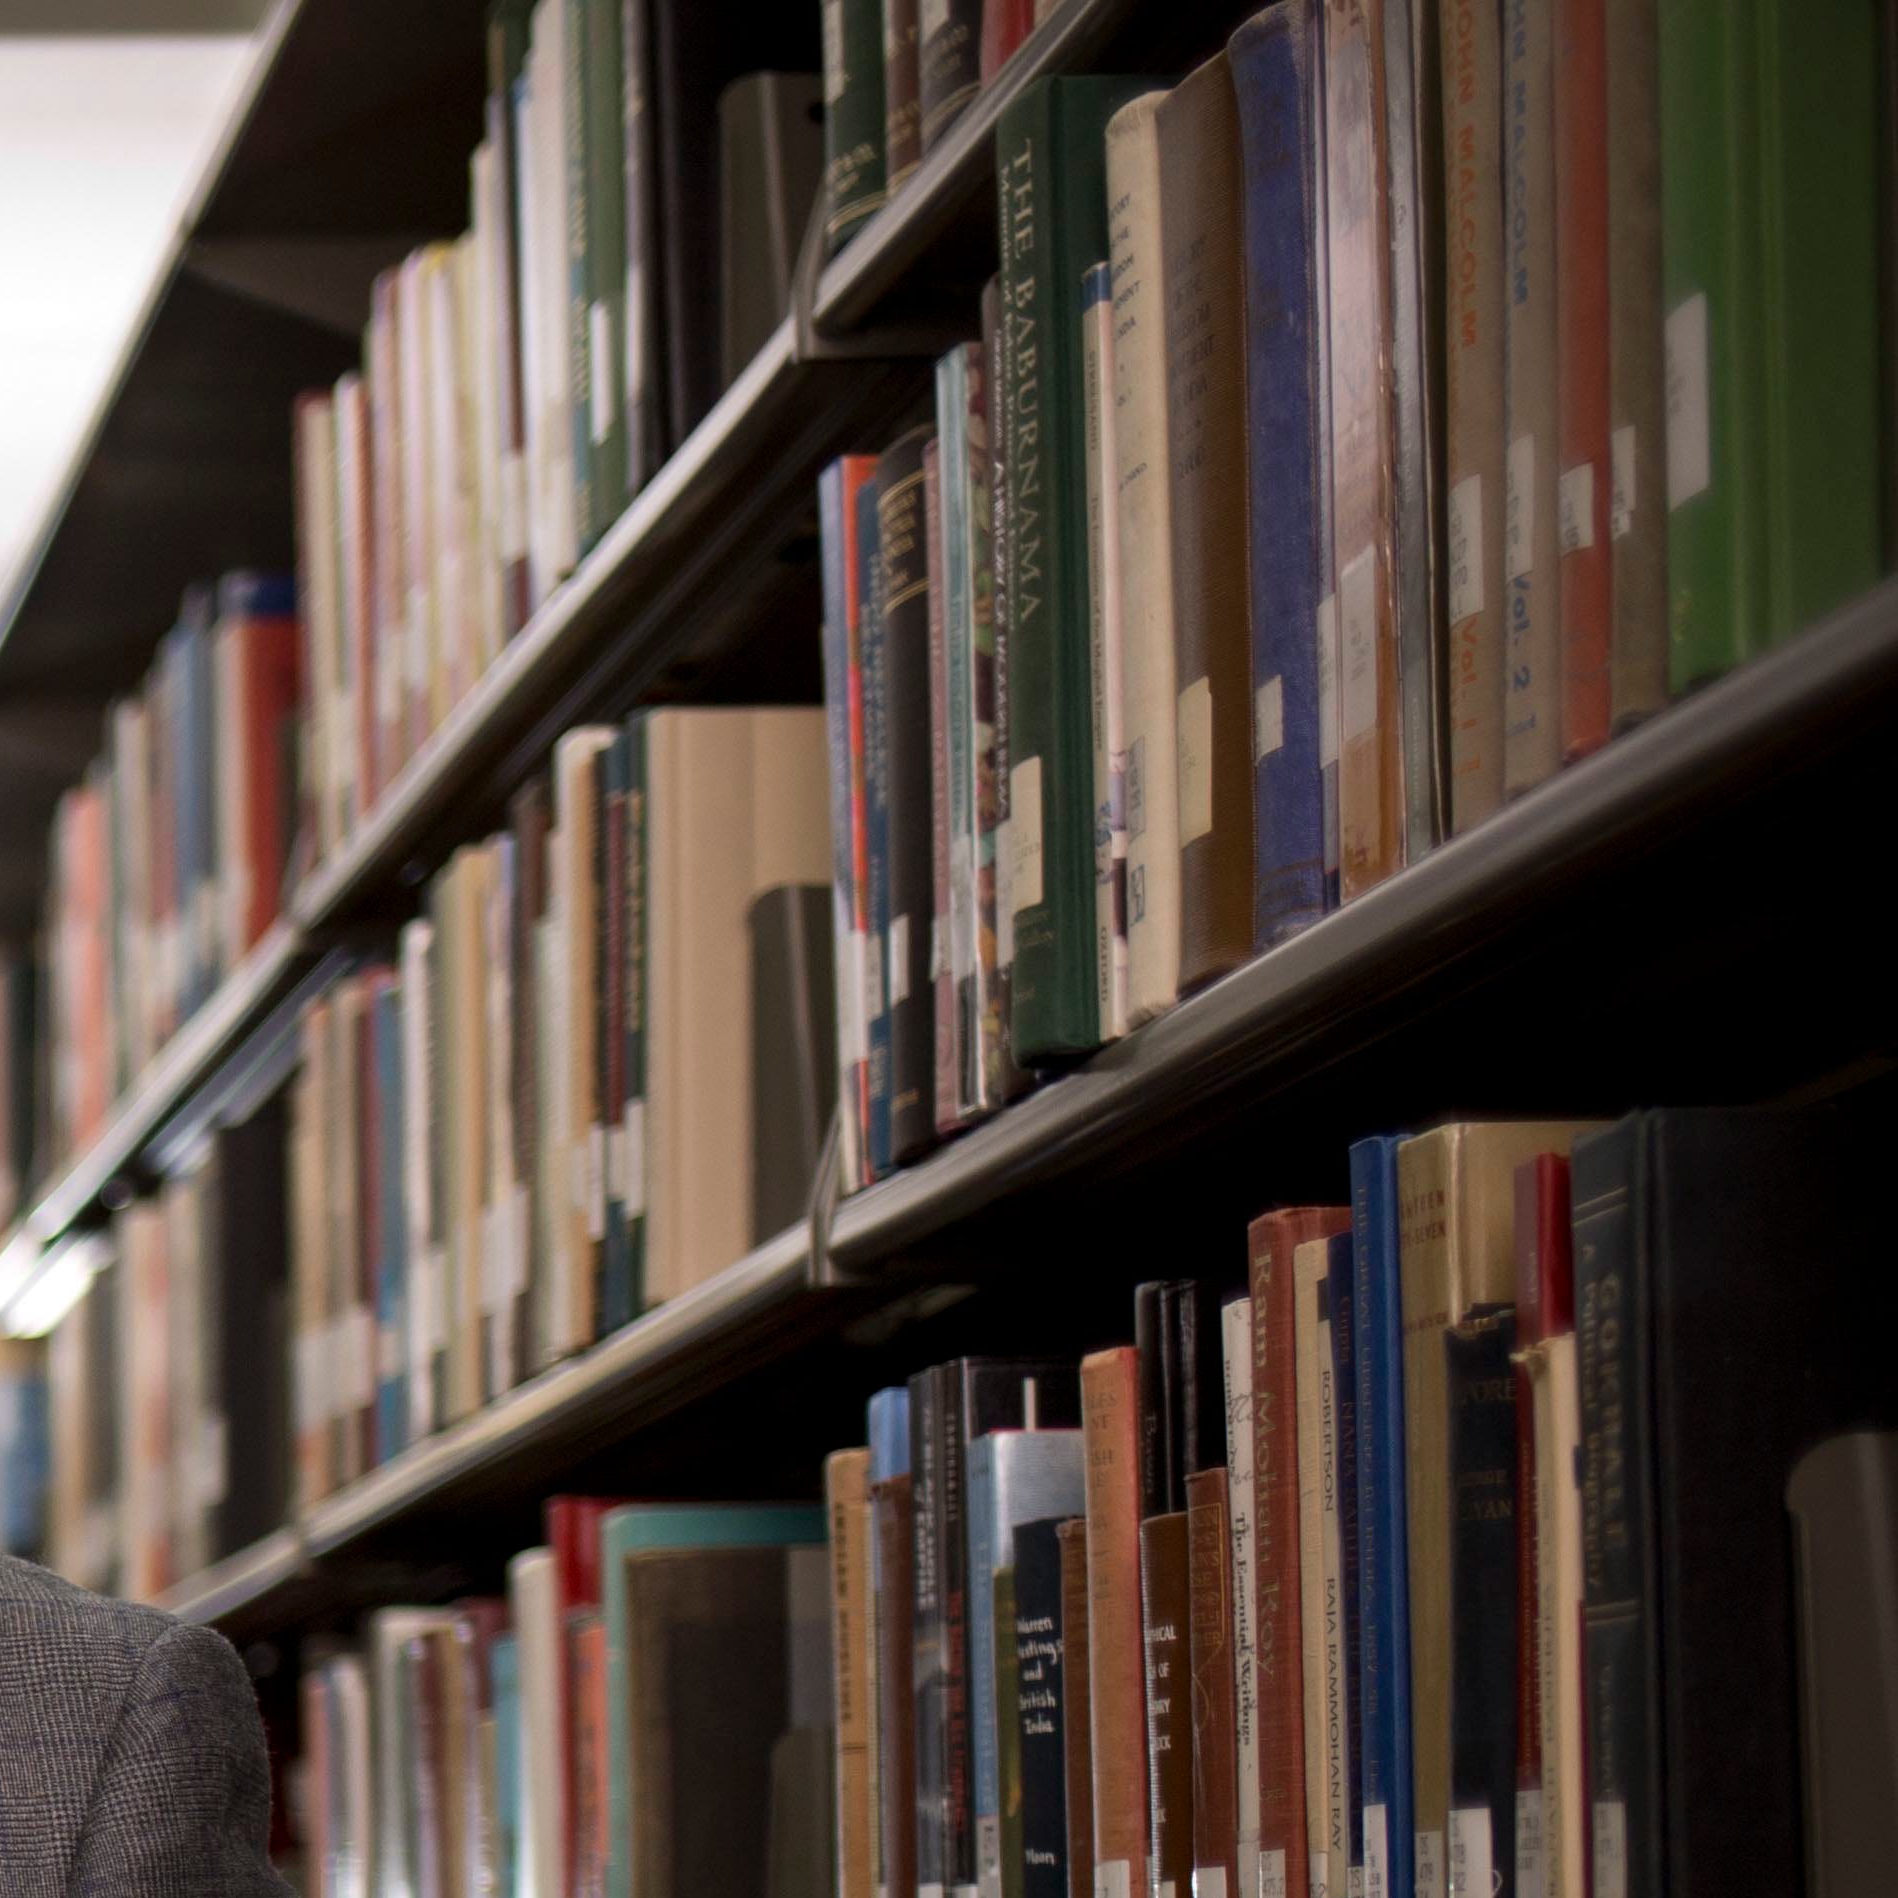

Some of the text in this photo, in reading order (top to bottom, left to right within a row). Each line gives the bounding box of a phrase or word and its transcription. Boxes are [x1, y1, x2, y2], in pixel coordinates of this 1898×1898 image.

[1458, 125, 1477, 347] MALCOLM
[1511, 80, 1529, 304] MALCOLM
[1012, 138, 1042, 622] THE BABURNAMA
[1458, 618, 1480, 698] Vol.
[1512, 664, 1531, 692] 2
[1582, 1281, 1597, 1409] Political
[1597, 1271, 1631, 1551] GOKHALE
[1254, 1252, 1281, 1687] Ram Mohan Roy
[1234, 1512, 1254, 1746] The Essential Writings
[1321, 1369, 1342, 1851] ROBERTSON RAJA RAMMOHAN RAY
